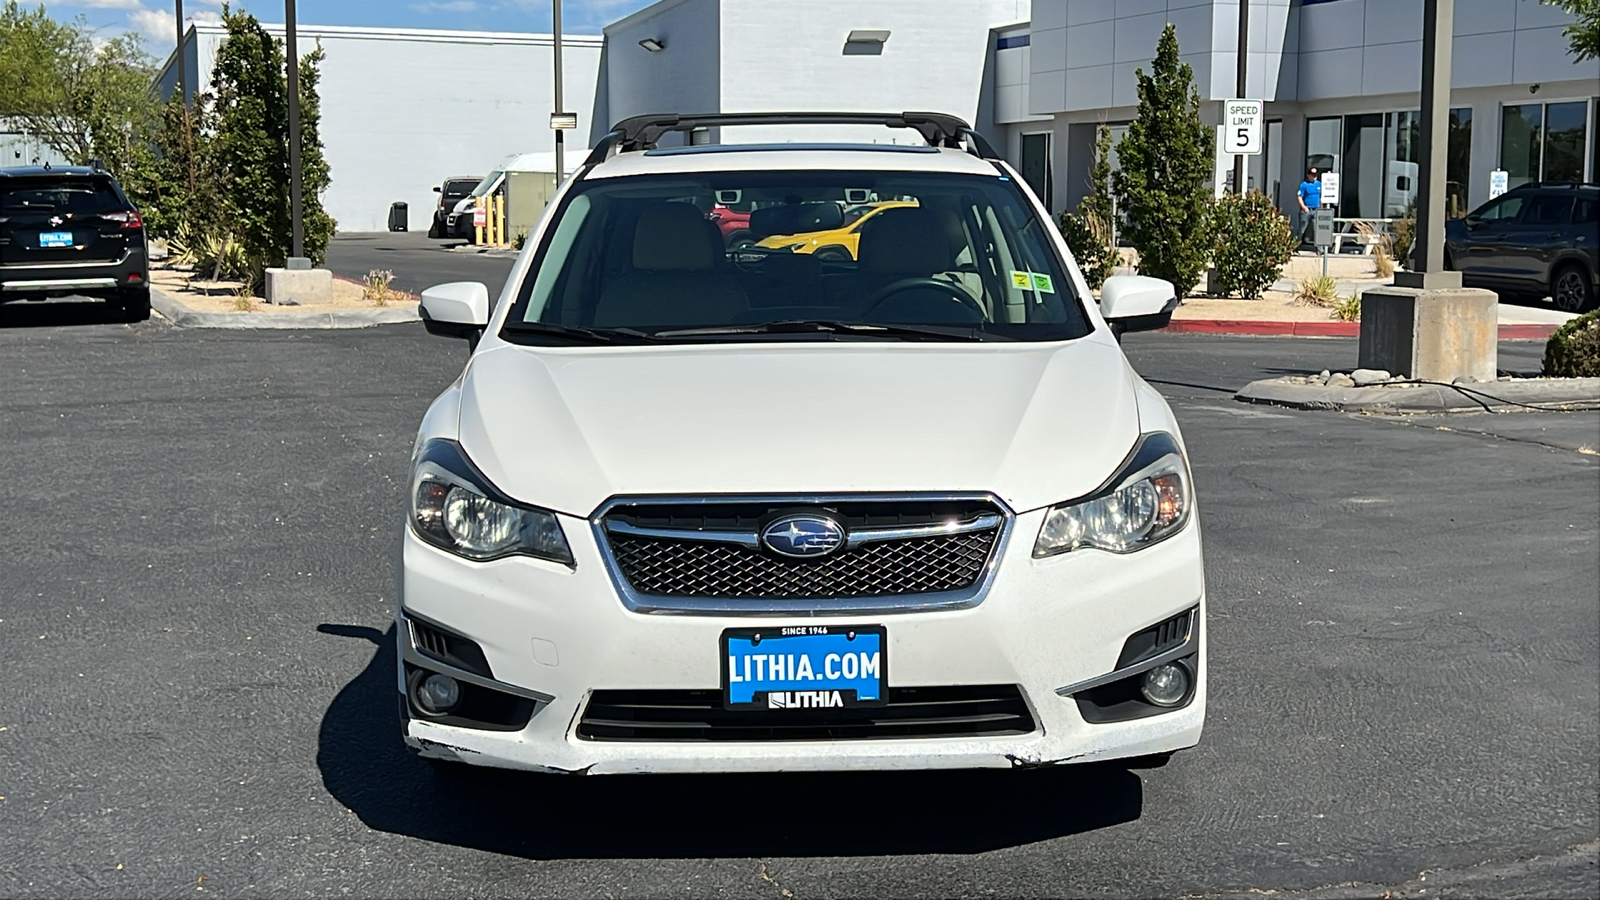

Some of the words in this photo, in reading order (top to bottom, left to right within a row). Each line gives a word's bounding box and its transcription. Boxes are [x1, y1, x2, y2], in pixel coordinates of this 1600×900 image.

[1230, 106, 1258, 114] SPEED
[1232, 117, 1254, 126] LIMIT
[1236, 128, 1249, 147] 5
[781, 627, 807, 635] SINCE
[808, 626, 828, 635] 1946
[729, 651, 880, 683] LITHIA.COM
[785, 690, 844, 709] LITHIA
